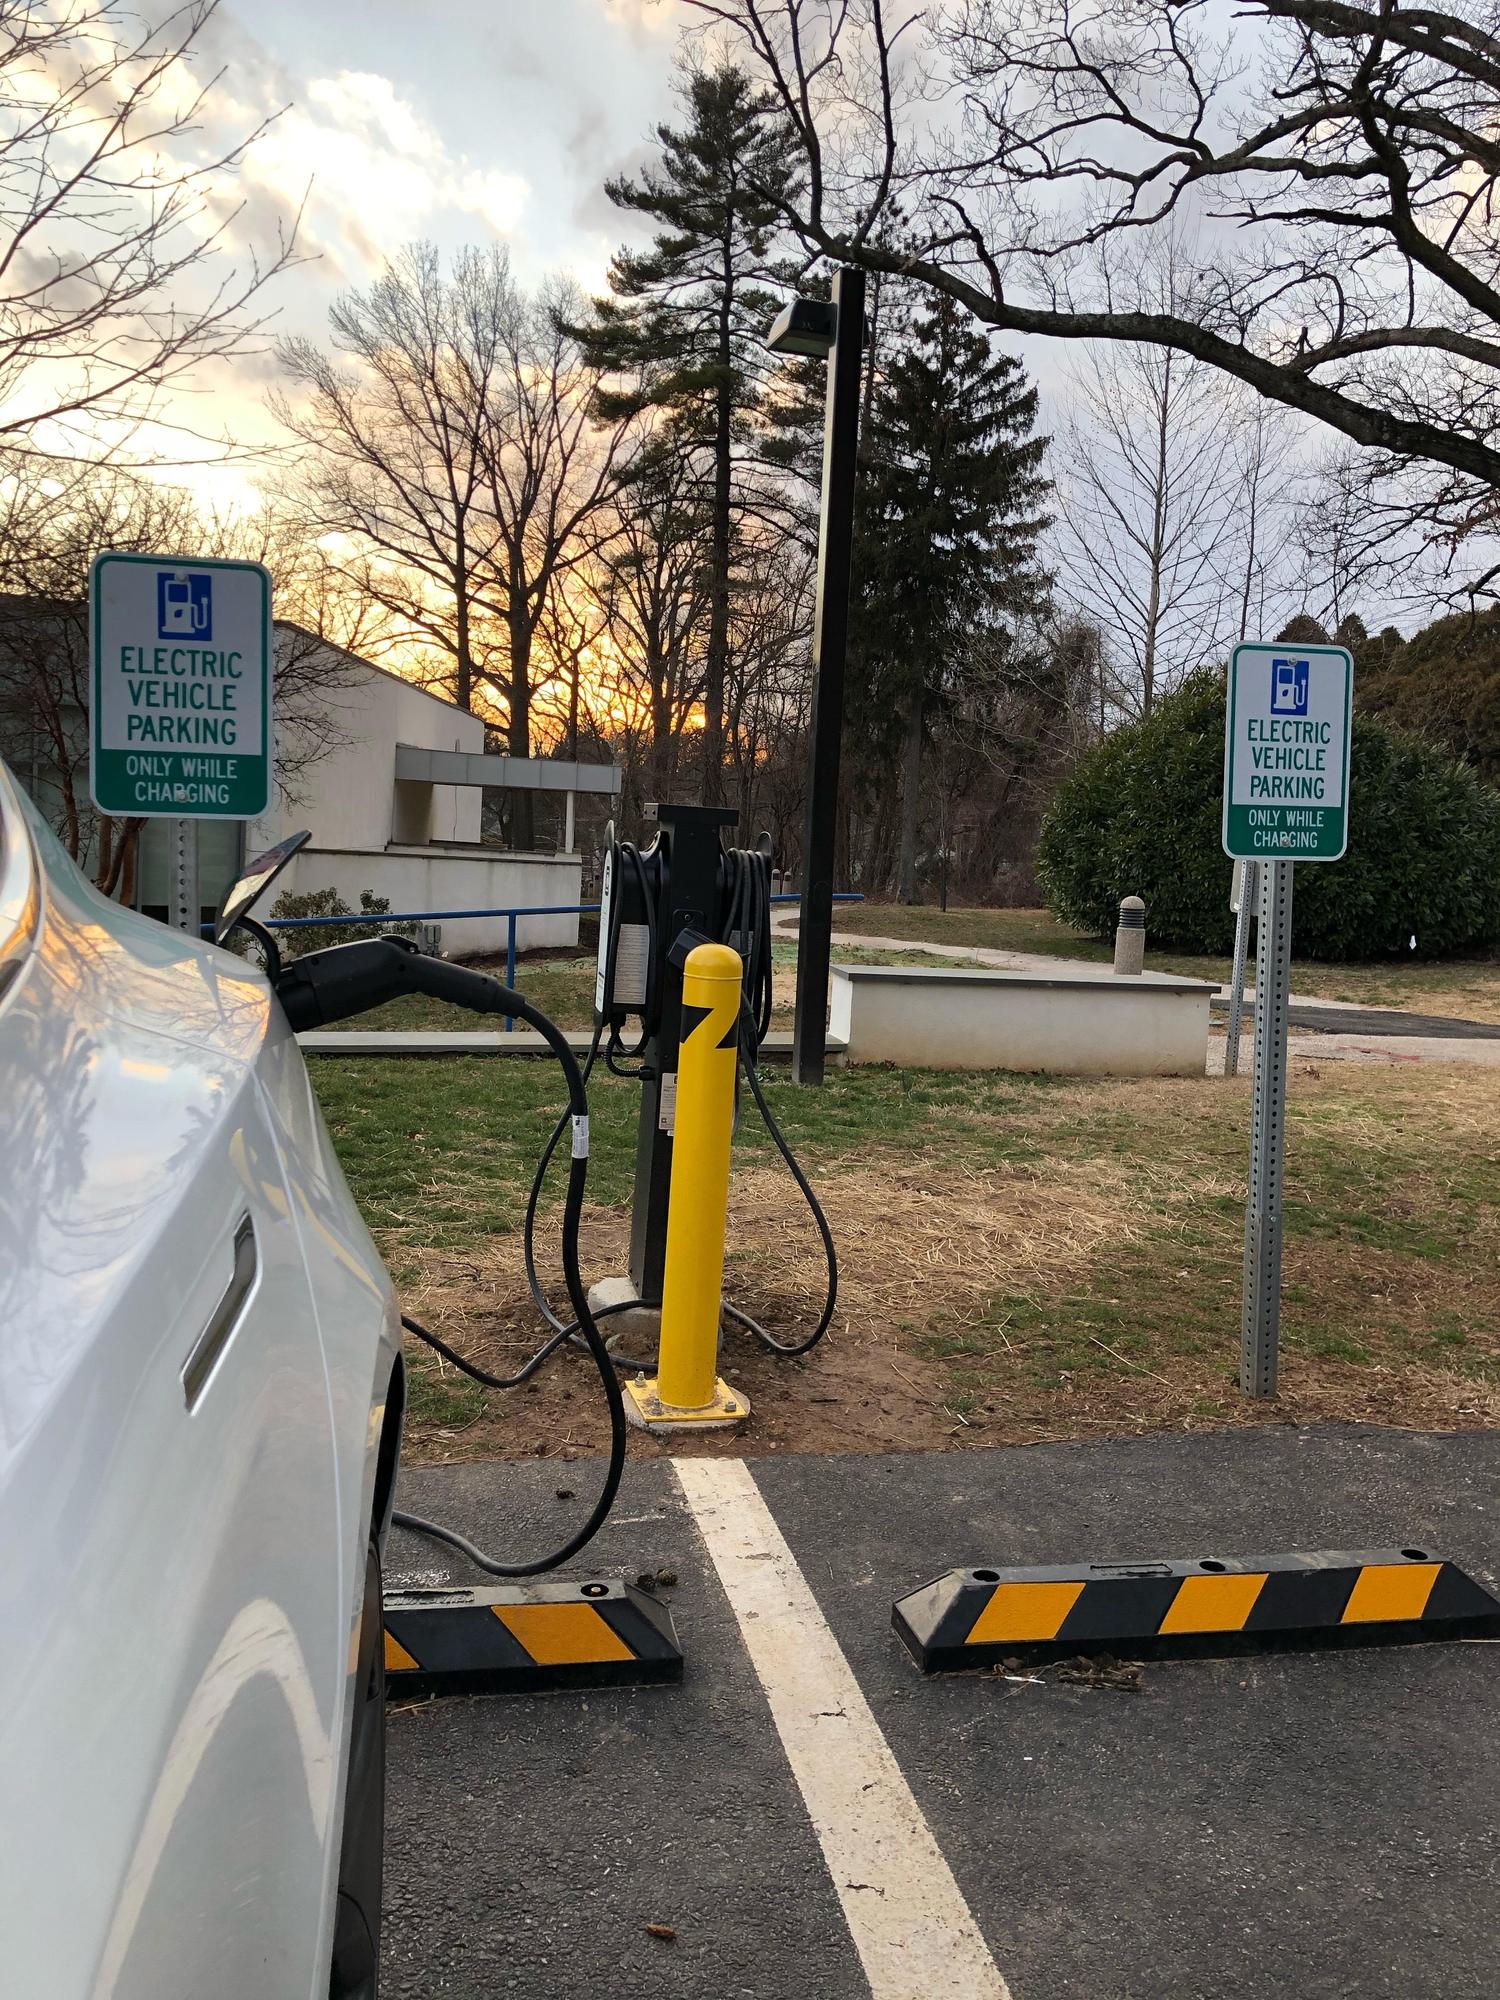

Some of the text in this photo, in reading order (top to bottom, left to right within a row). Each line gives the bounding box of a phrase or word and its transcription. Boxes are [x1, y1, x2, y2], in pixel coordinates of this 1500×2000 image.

[120, 645, 243, 679] ELECTRIC
[127, 679, 237, 712] VEHICLE
[127, 714, 237, 746] PARKING
[1247, 718, 1331, 745] ELECTRIC
[126, 755, 238, 779] ONLY WHILE
[1251, 746, 1326, 771] VEHICLE
[135, 781, 230, 805] CHARGING
[1250, 775, 1325, 800] PARKING
[1248, 809, 1325, 828] ONLY WHILE
[1253, 830, 1318, 848] CHARGING
